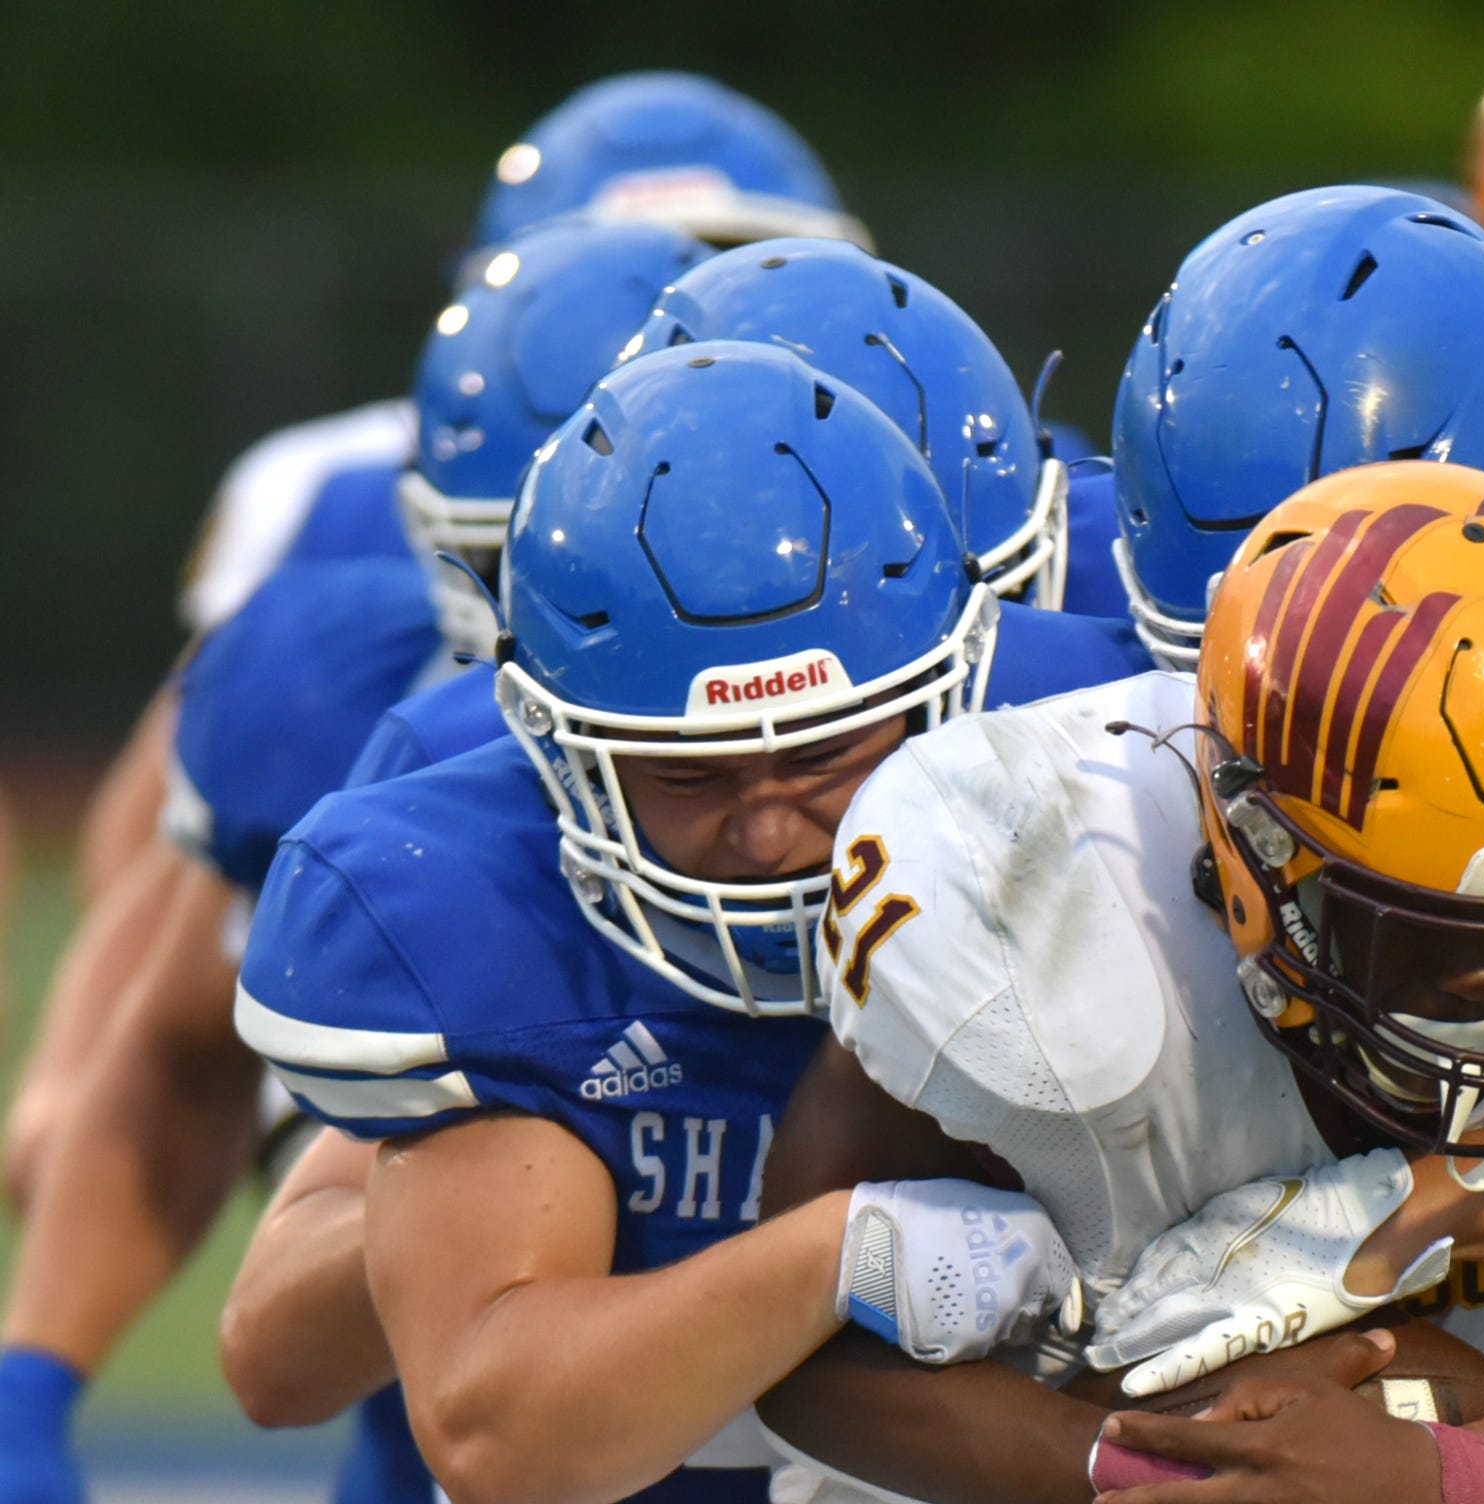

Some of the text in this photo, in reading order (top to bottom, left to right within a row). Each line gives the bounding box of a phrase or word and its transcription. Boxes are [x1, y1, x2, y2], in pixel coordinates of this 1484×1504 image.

[705, 659, 829, 705] Riddell
[823, 833, 922, 1010] 21
[579, 1061, 683, 1100] adidas
[960, 1206, 1000, 1331] adidas
